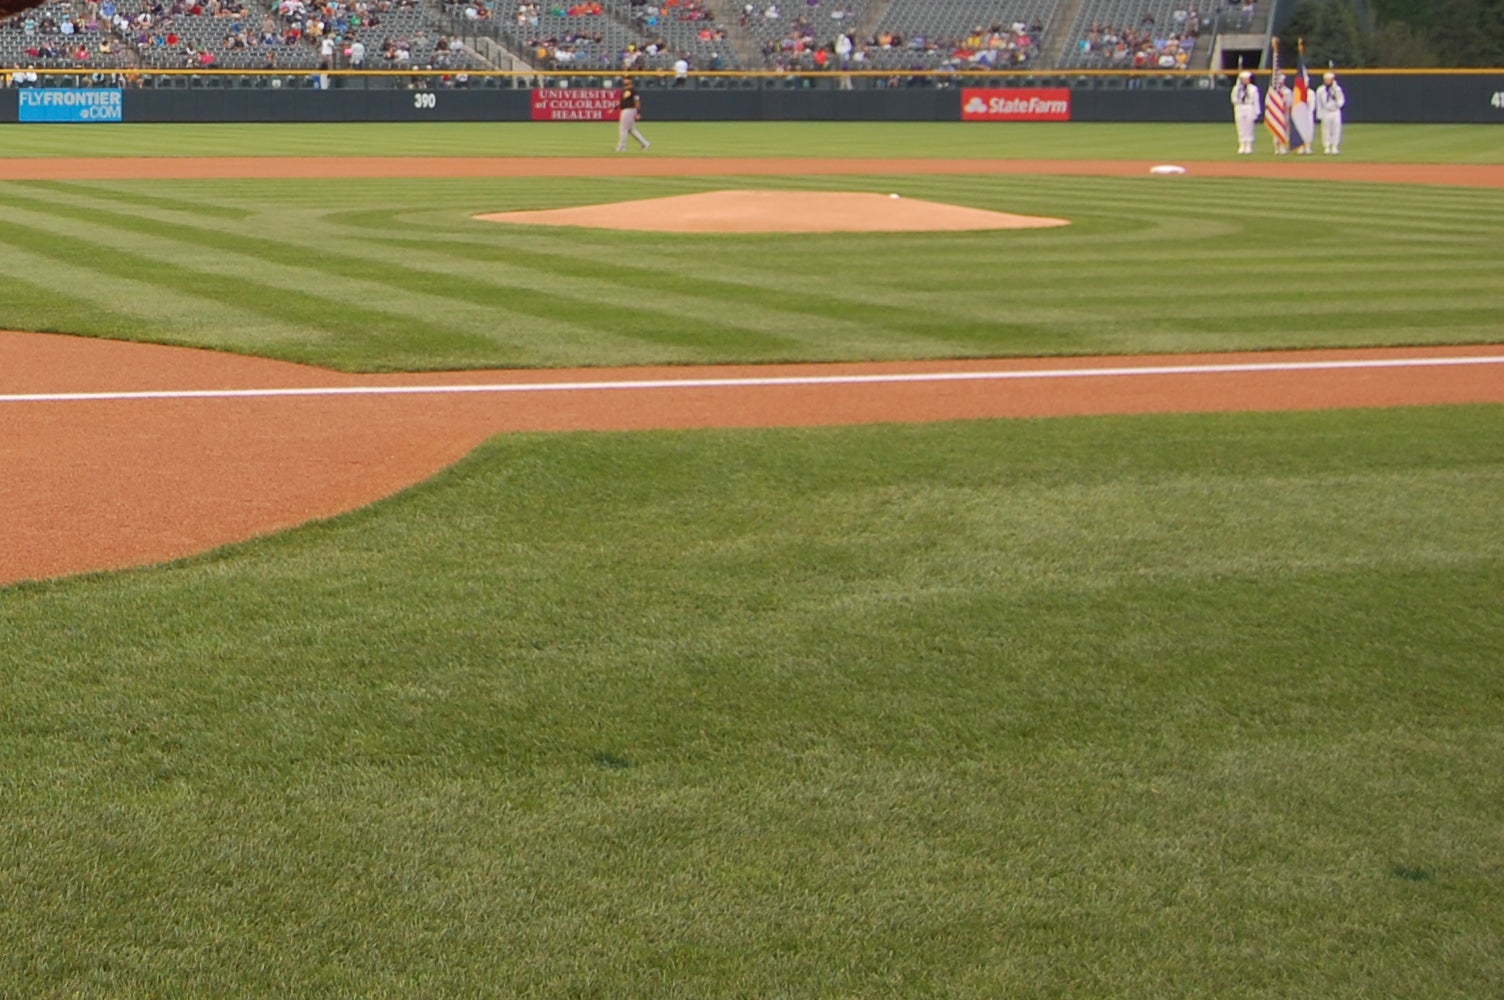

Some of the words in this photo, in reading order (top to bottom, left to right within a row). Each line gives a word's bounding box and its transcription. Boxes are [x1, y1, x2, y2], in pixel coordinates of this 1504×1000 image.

[20, 91, 121, 106] FLYFRONTIER
[540, 90, 615, 99] UNIVERSITY
[414, 93, 436, 109] 390
[536, 99, 547, 109] of
[552, 110, 602, 120] HEALTH
